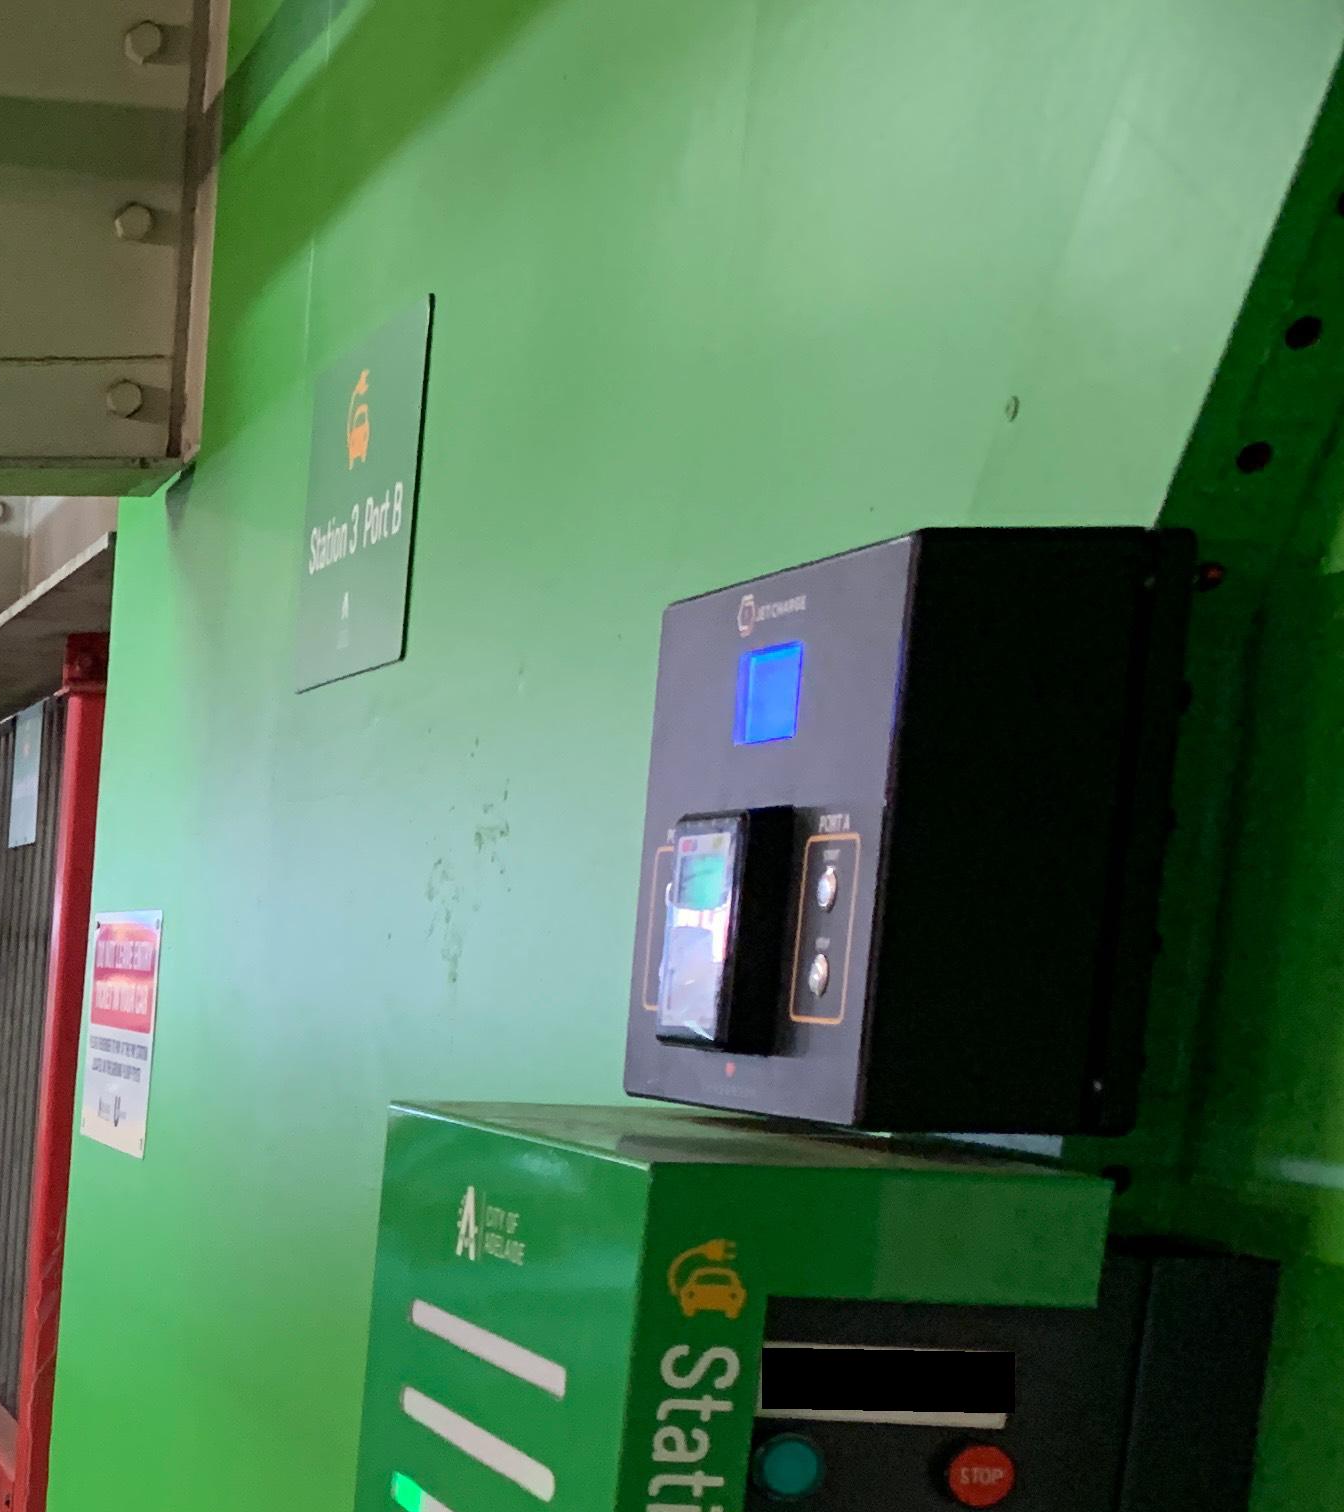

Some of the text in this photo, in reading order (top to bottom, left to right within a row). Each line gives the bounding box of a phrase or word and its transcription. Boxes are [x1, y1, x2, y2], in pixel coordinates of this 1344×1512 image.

[309, 482, 403, 575] Station 3 Port B
[506, 1211, 520, 1234] OF
[959, 1466, 1004, 1486] STOP
